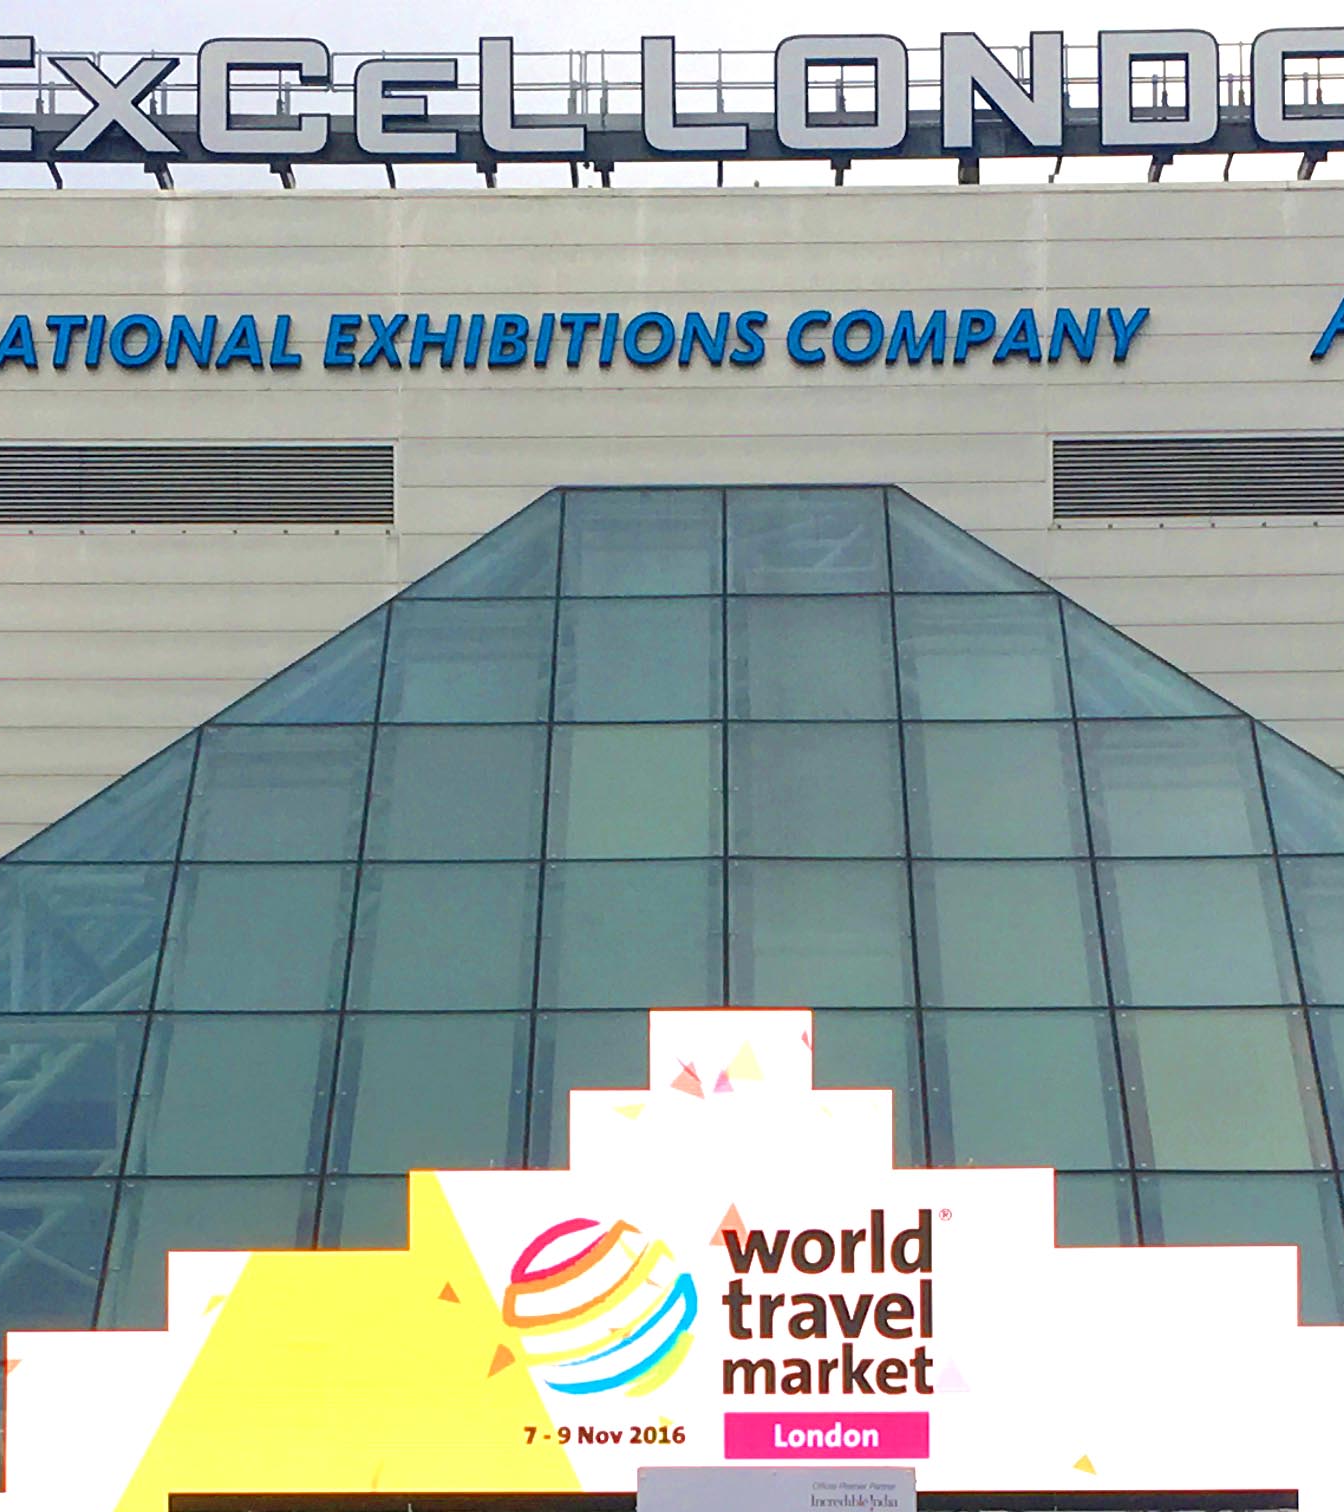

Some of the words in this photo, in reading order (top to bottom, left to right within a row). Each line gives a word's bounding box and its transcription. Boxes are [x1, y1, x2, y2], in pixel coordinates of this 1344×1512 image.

[323, 311, 769, 368] EXHIBITIONS
[786, 308, 1152, 365] COMPANY
[722, 1209, 933, 1274] world
[722, 1279, 934, 1340] travel
[722, 1343, 935, 1395] market
[524, 1427, 536, 1444] 7
[558, 1427, 571, 1444] 9
[578, 1427, 623, 1444] Nov
[629, 1427, 686, 1444] 2016
[774, 1423, 879, 1448] London
